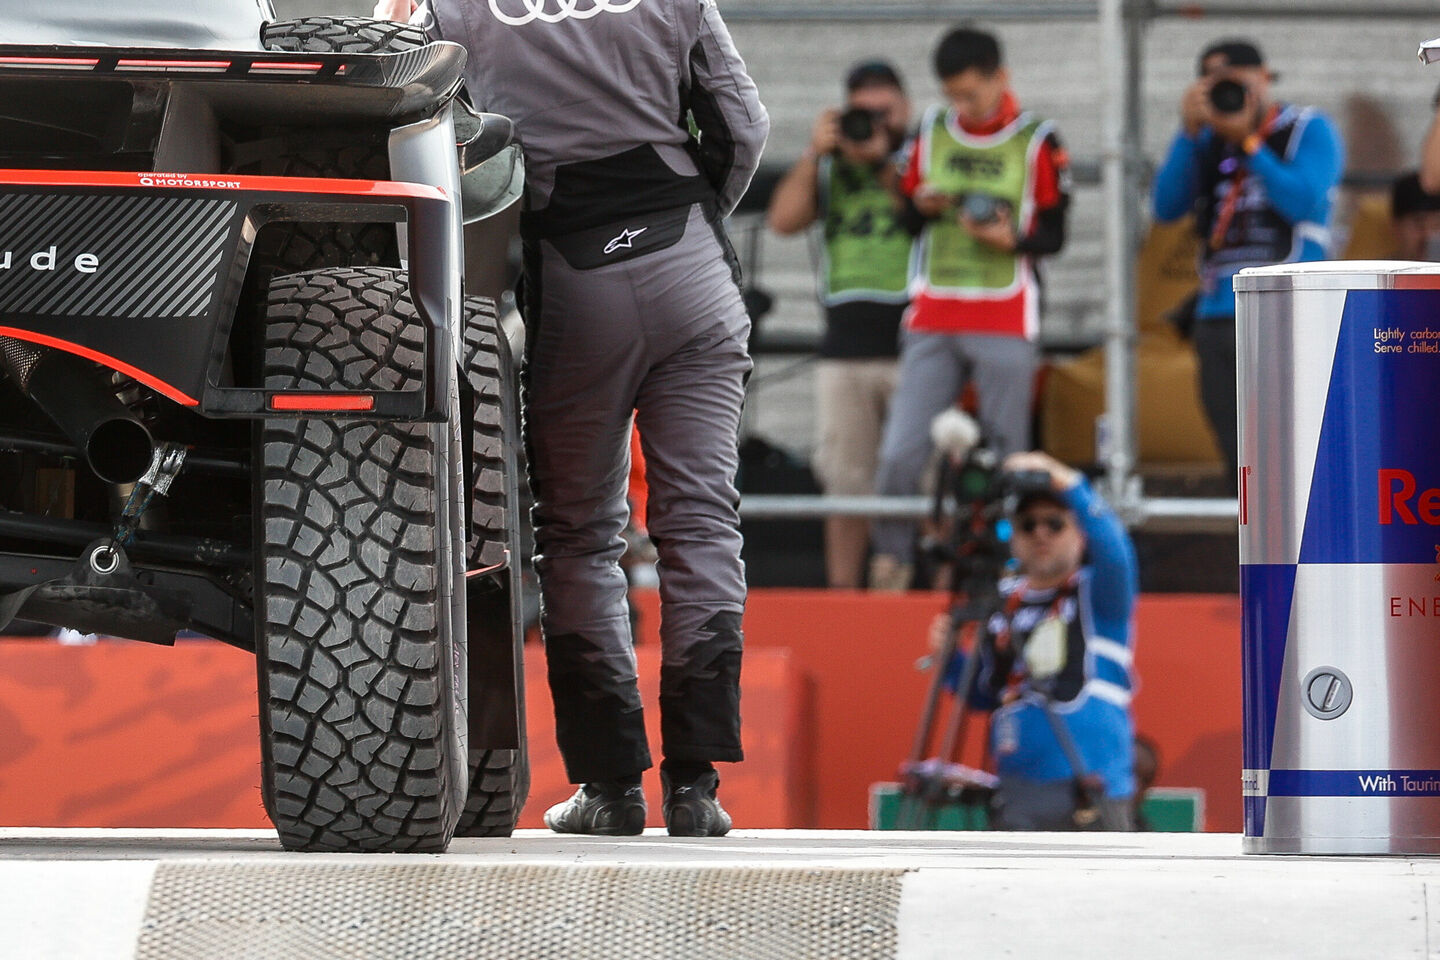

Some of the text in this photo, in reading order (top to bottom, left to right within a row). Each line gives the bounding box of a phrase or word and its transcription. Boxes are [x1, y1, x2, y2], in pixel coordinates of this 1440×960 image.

[176, 172, 188, 180] by
[155, 178, 241, 189] MOTORSPORT
[1373, 327, 1406, 342] Lightly
[1374, 341, 1403, 353] Serve
[1358, 774, 1397, 792] With
